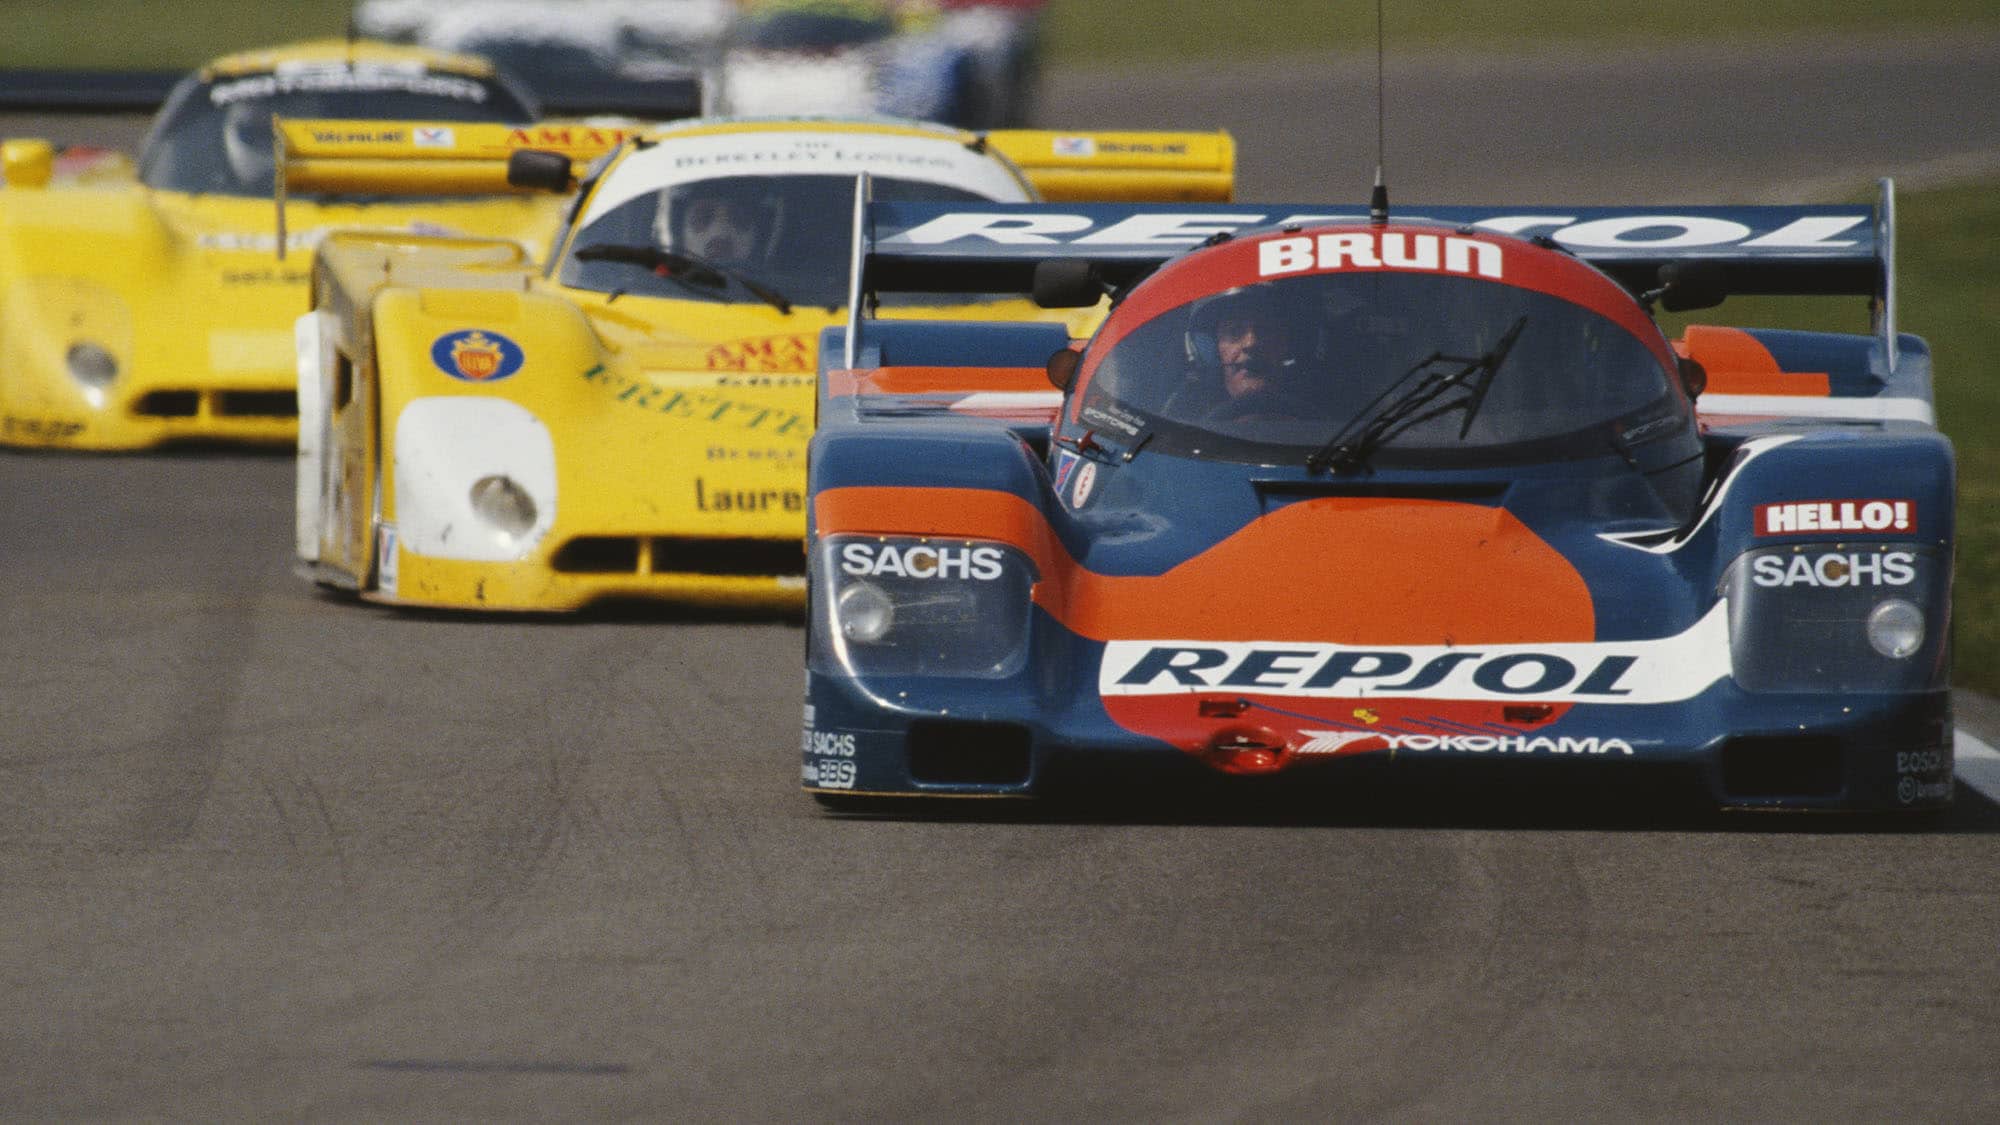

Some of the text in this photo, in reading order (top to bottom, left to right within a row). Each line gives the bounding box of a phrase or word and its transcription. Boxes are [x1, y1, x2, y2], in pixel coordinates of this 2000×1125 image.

[1259, 232, 1503, 279] BRUN
[1767, 502, 1909, 533] HELLO!
[842, 542, 1004, 581] SACHS
[1753, 551, 1916, 587] SACHS
[1115, 647, 1638, 696] REPSOL
[813, 731, 856, 757] SACHS
[1378, 733, 1634, 755] YOKOHAMA
